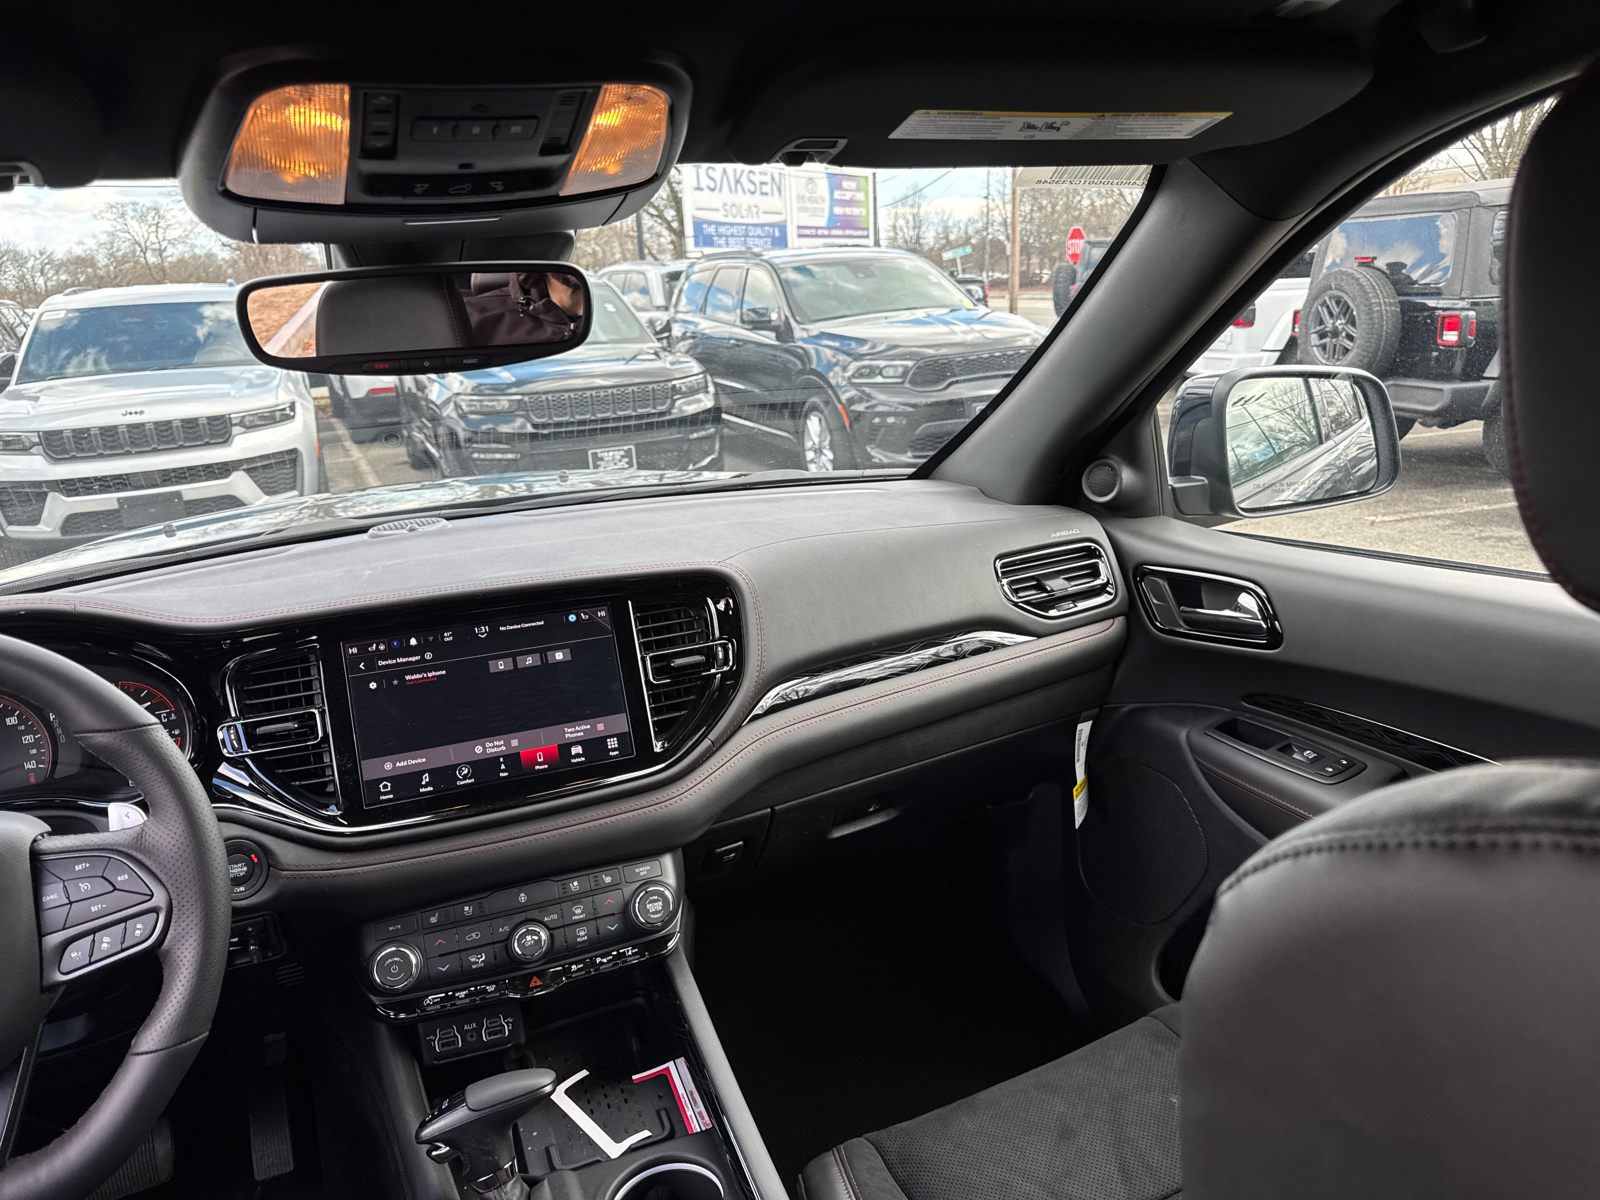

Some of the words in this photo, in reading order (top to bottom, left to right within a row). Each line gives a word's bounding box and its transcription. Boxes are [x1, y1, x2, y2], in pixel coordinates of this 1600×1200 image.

[692, 165, 782, 198] ISAKSEN
[722, 202, 760, 219] SOLAR
[702, 224, 716, 235] THE
[717, 224, 746, 236] HIGHEST
[747, 226, 773, 236] QUALITY
[712, 236, 727, 247] THE
[728, 237, 744, 248] BEST
[746, 238, 772, 248] SERVICE
[1051, 528, 1080, 538] AIRBAG
[521, 620, 544, 628] Connected
[397, 655, 420, 664] Manager
[405, 672, 426, 680] Waldo's
[428, 670, 446, 678] iphone
[6, 716, 18, 726] 100
[22, 734, 35, 744] 120
[24, 760, 37, 770] 140
[42, 894, 58, 902] CANC
